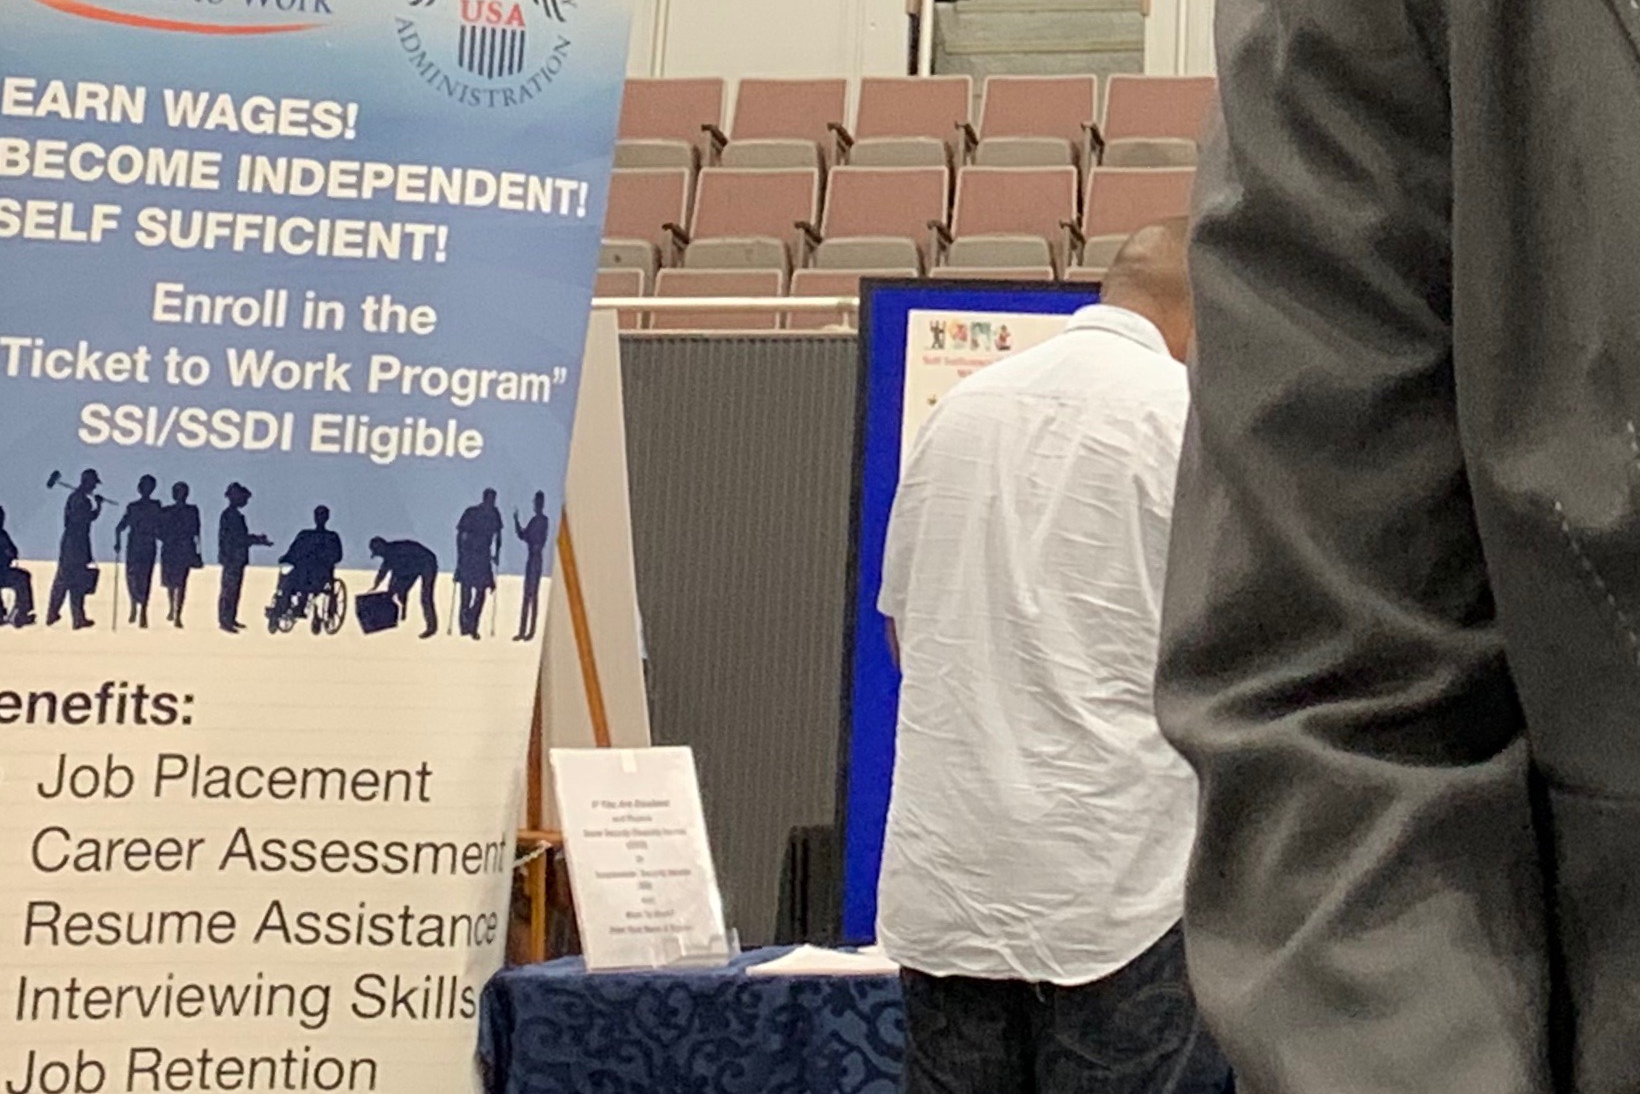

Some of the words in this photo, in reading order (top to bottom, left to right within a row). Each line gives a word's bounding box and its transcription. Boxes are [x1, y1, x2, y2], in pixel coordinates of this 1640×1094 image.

[394, 15, 571, 108] ADMINISTRATION
[1, 76, 146, 124] EARN
[163, 88, 359, 140] WAGES!
[0, 136, 223, 190] BECOME
[237, 154, 589, 218] INDEPENDENT!
[0, 197, 122, 243] SELF
[135, 206, 448, 263] SUFFICIENT!
[152, 281, 289, 328] Enroll
[303, 290, 344, 331] in
[361, 294, 438, 335] the
[0, 336, 151, 384] Ticket
[164, 346, 211, 385] to
[226, 347, 352, 392] Work
[78, 403, 293, 453] SSI/SSDI
[310, 414, 484, 464] Eligible
[37, 753, 135, 799] Job
[154, 753, 433, 802] Placement
[32, 826, 204, 872] Career
[219, 826, 506, 875] Assessment
[24, 900, 236, 946] Resume
[252, 900, 497, 948] Assistance
[16, 971, 330, 1030] Interviewing
[351, 973, 476, 1020] Skills
[6, 1048, 105, 1094] Job
[127, 1046, 378, 1093] Retention
